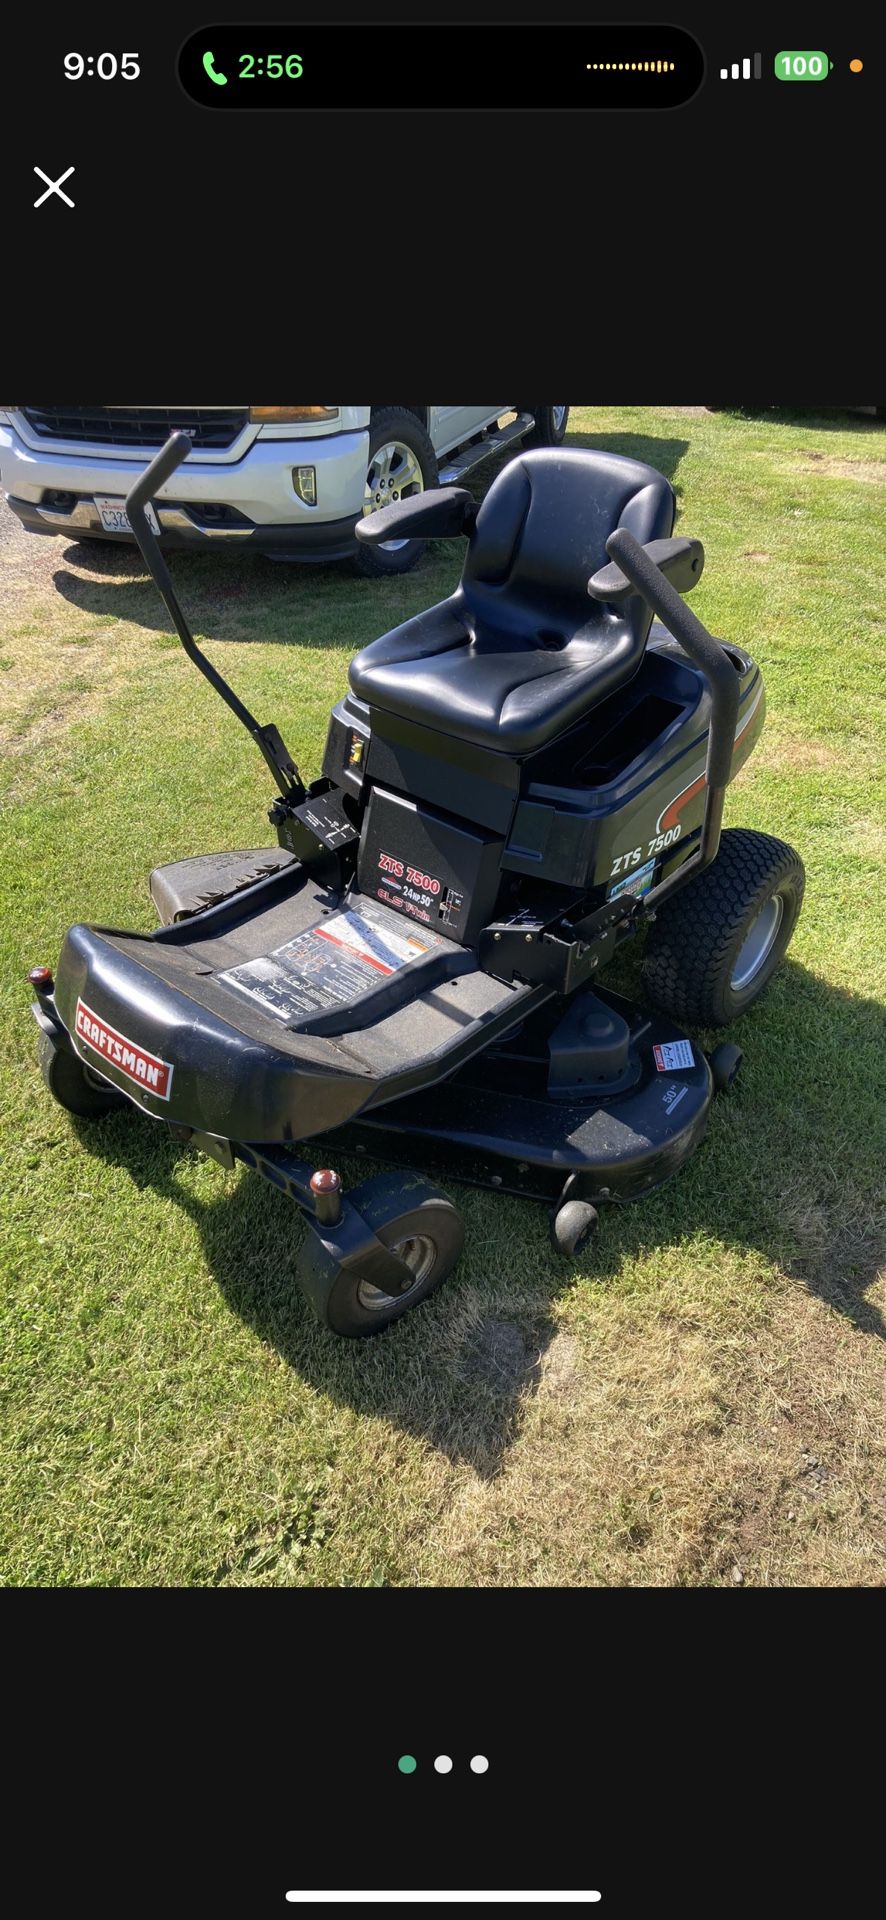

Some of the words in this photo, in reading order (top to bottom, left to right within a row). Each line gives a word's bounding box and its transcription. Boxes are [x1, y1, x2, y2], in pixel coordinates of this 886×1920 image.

[378, 853, 404, 877] ZTS
[406, 866, 440, 895] 7500
[610, 847, 642, 877] ZTS
[647, 824, 681, 856] 7500
